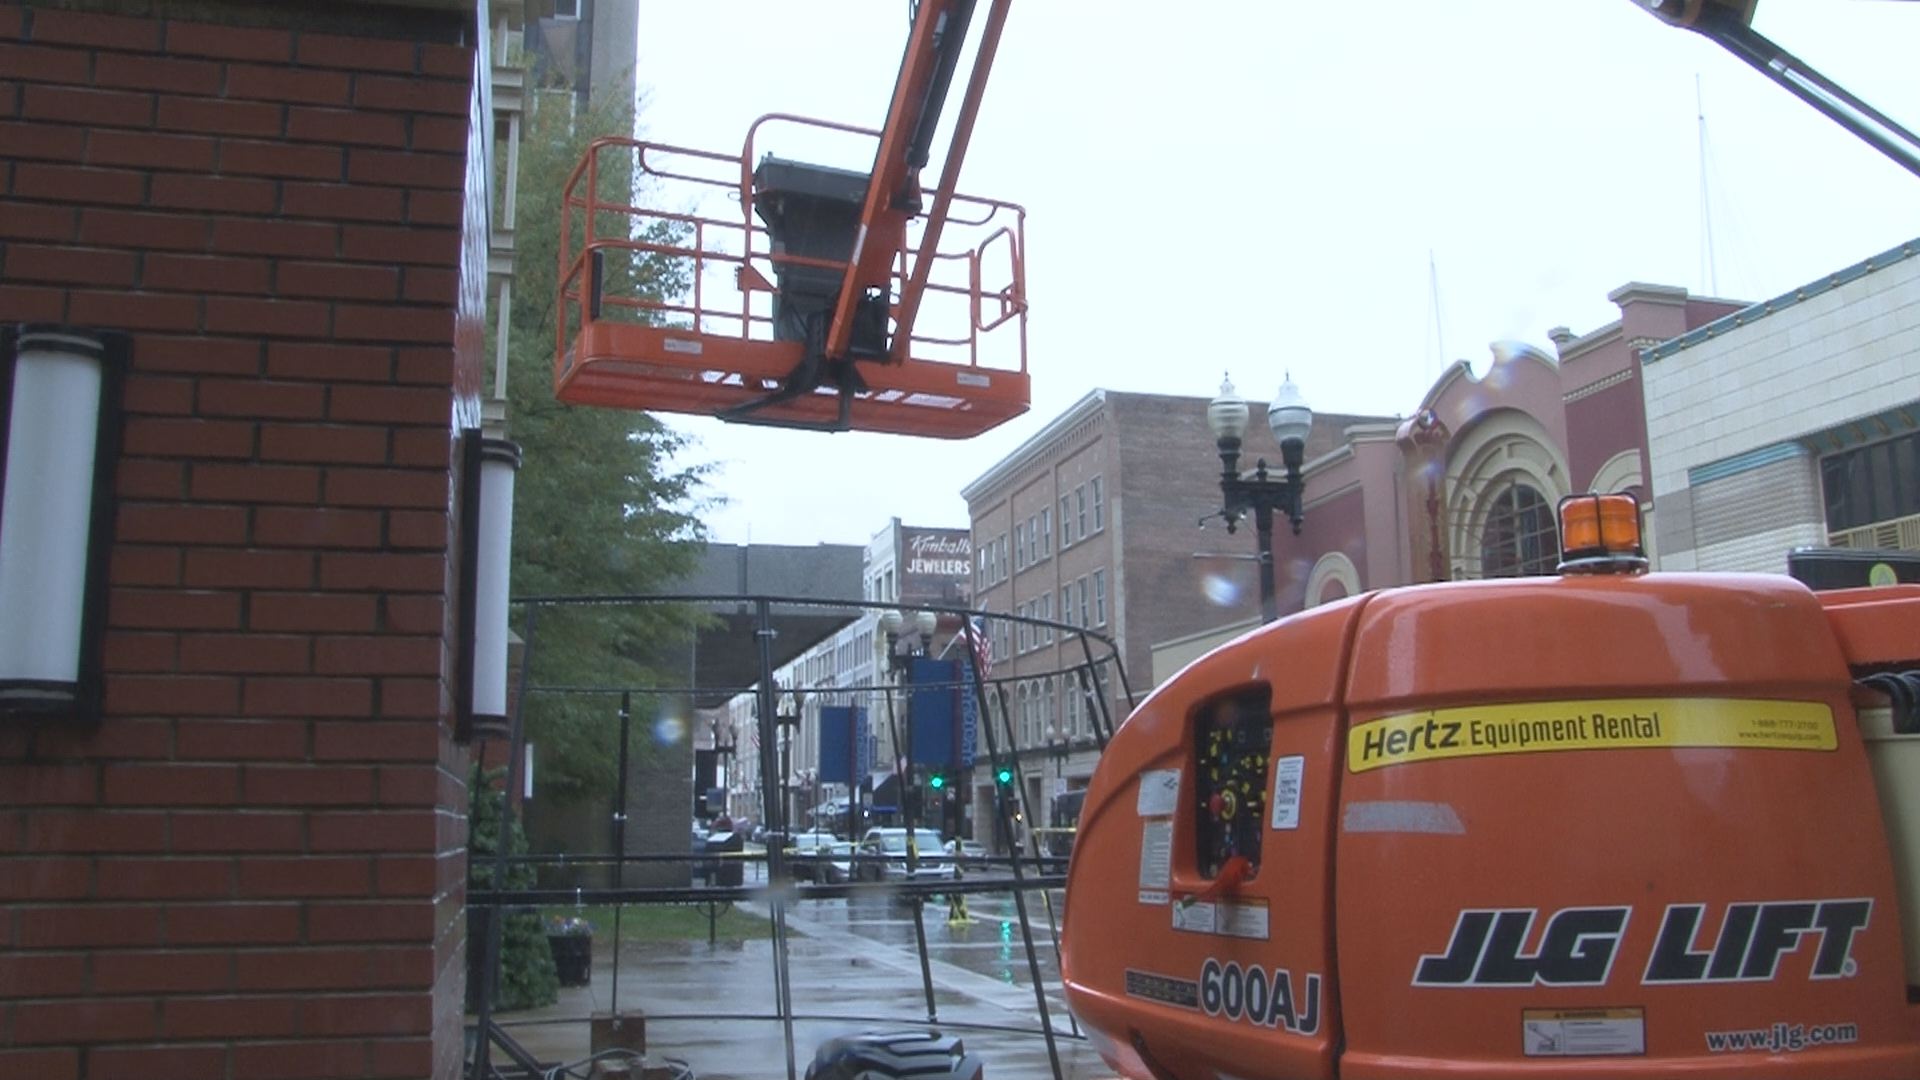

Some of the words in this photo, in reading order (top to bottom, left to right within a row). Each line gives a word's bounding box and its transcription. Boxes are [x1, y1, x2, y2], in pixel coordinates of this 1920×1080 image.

[906, 559, 971, 575] JEWELERS
[1363, 719, 1462, 761] Hertz
[1470, 715, 1587, 748] Equipment
[1592, 712, 1661, 739] Rental
[1411, 905, 1632, 987] JLG
[1641, 898, 1874, 985] LIFT
[1201, 957, 1322, 1036] 600AJ
[1705, 1023, 1858, 1052] www.jlg.com
